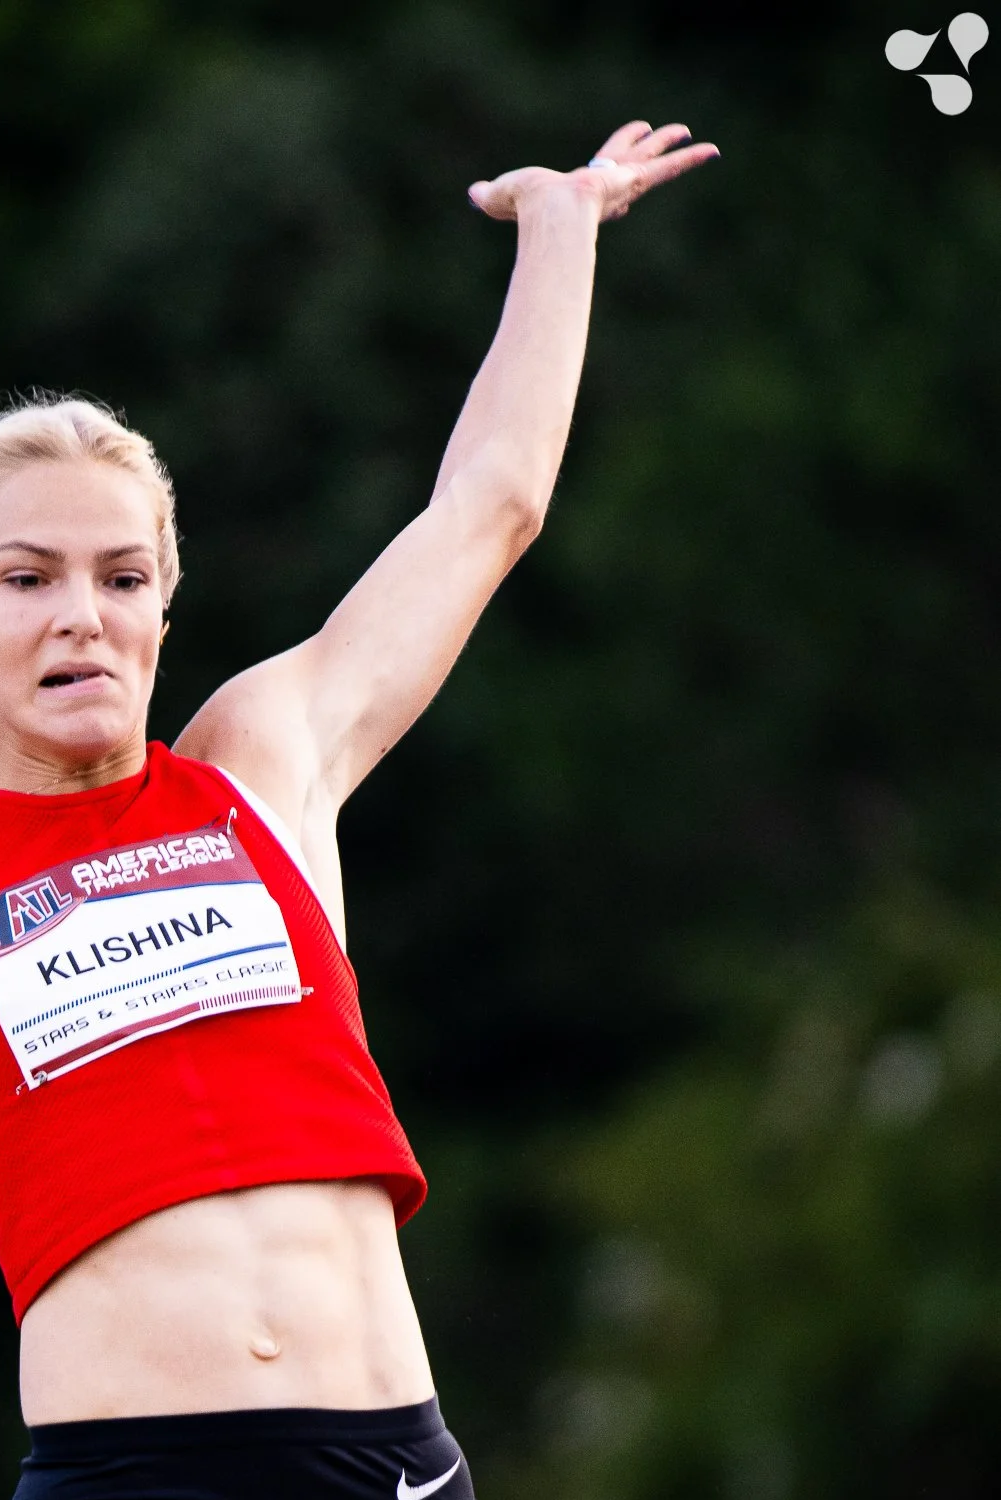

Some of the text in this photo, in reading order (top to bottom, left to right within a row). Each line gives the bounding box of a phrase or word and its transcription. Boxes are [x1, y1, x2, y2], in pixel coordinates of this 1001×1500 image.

[71, 832, 230, 887] AMERICAN
[81, 847, 235, 896] TRACK LEAGUE
[5, 876, 73, 941] ATL
[36, 907, 233, 986] KLISHINA
[24, 960, 288, 1054] STARS & STRIPES CLASSIC
